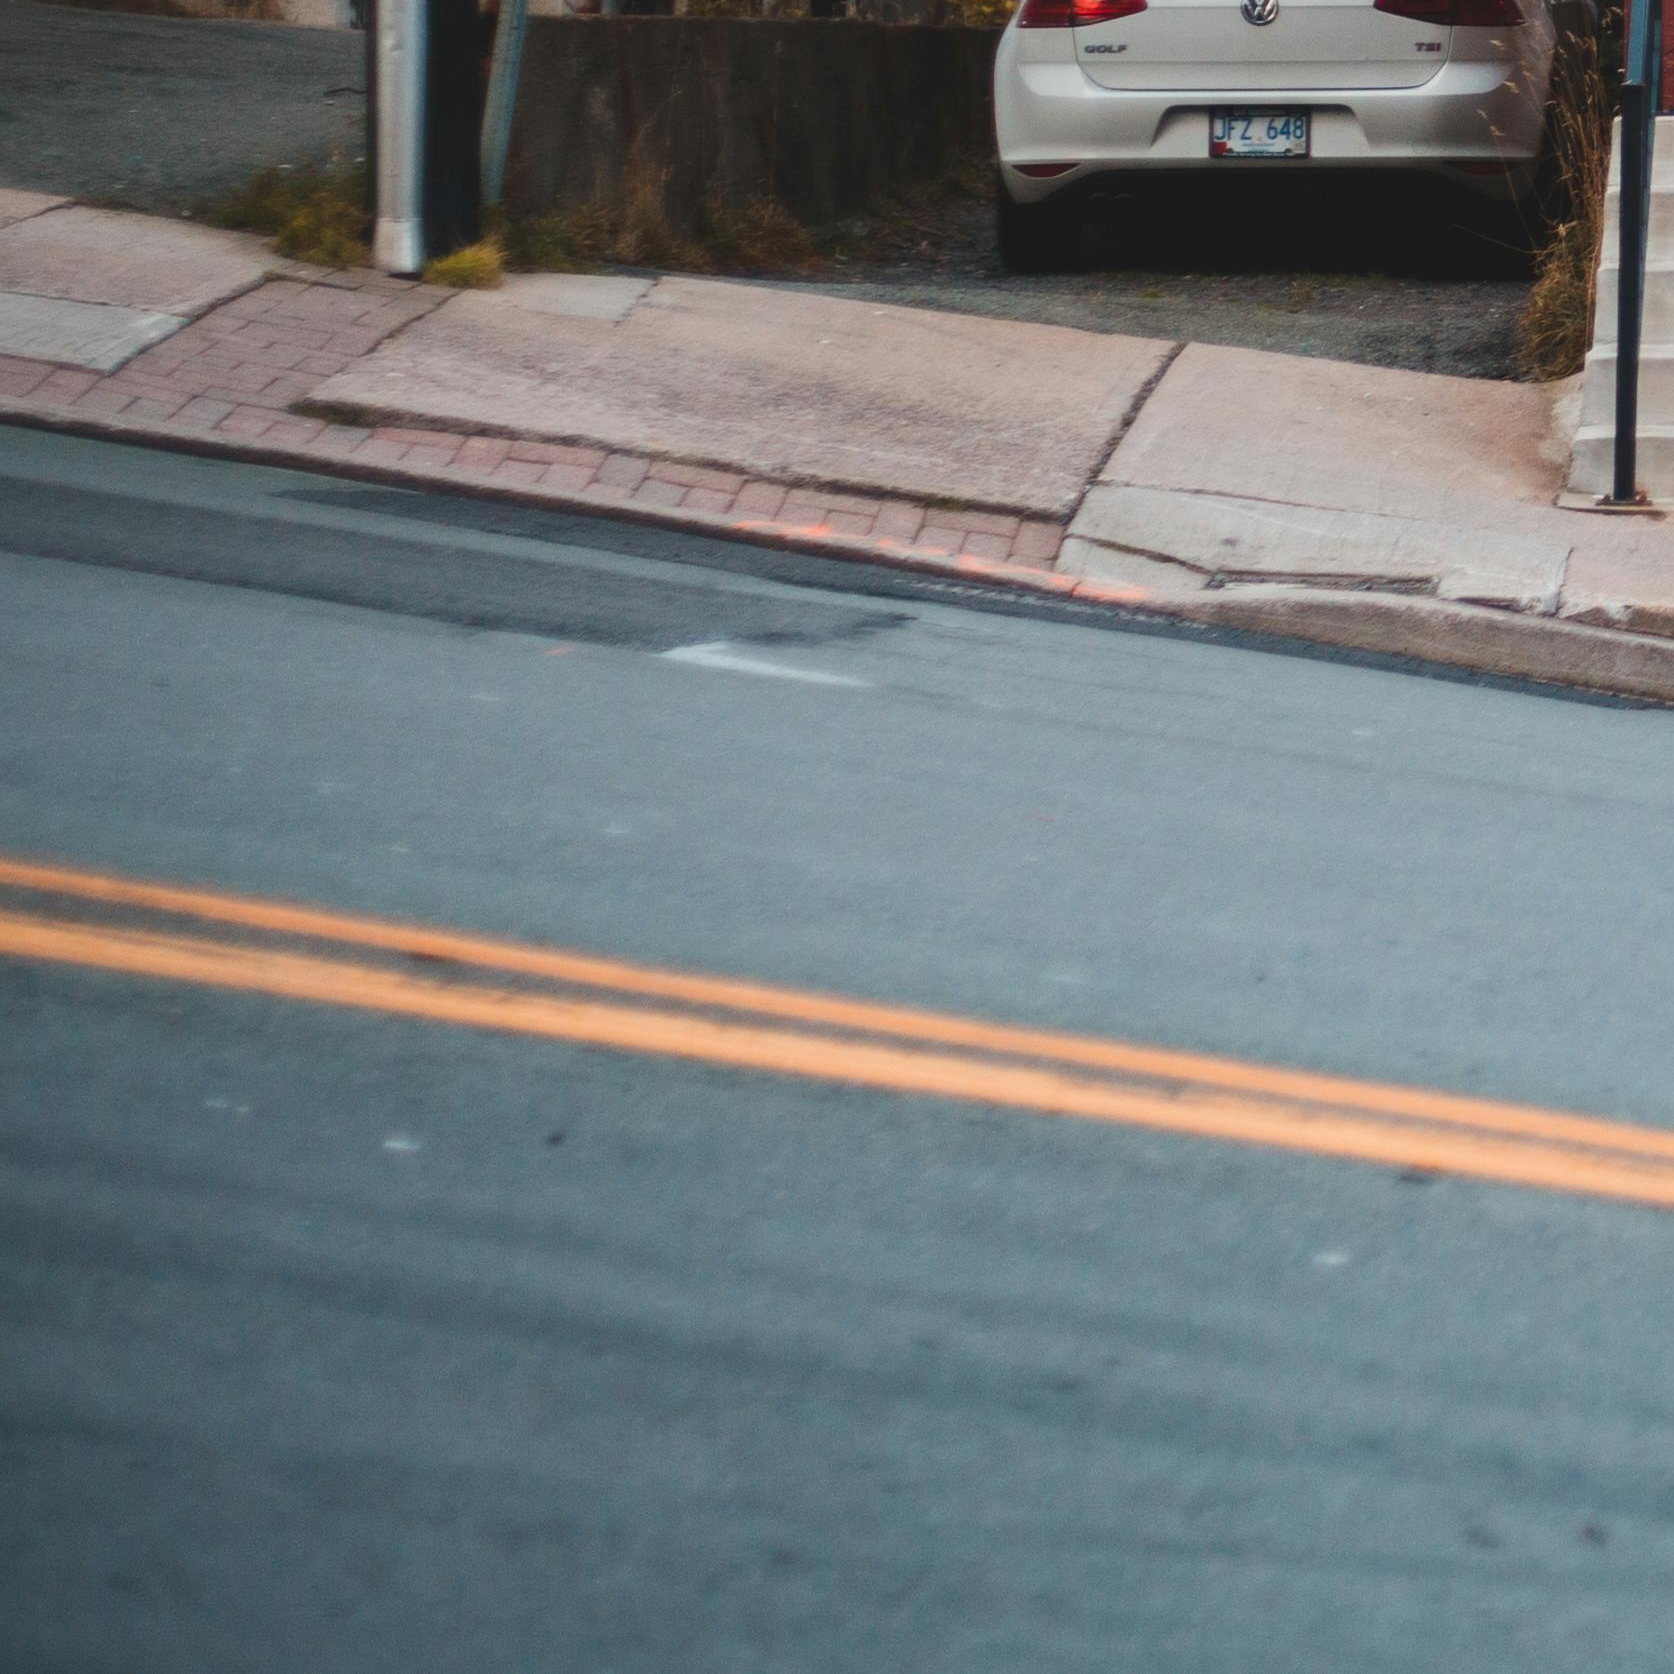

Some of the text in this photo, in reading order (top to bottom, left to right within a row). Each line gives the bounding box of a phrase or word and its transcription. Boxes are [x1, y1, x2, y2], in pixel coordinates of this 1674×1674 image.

[1084, 44, 1128, 54] GOLF
[1415, 42, 1441, 52] TSI
[1215, 117, 1305, 140] JFZ 648
